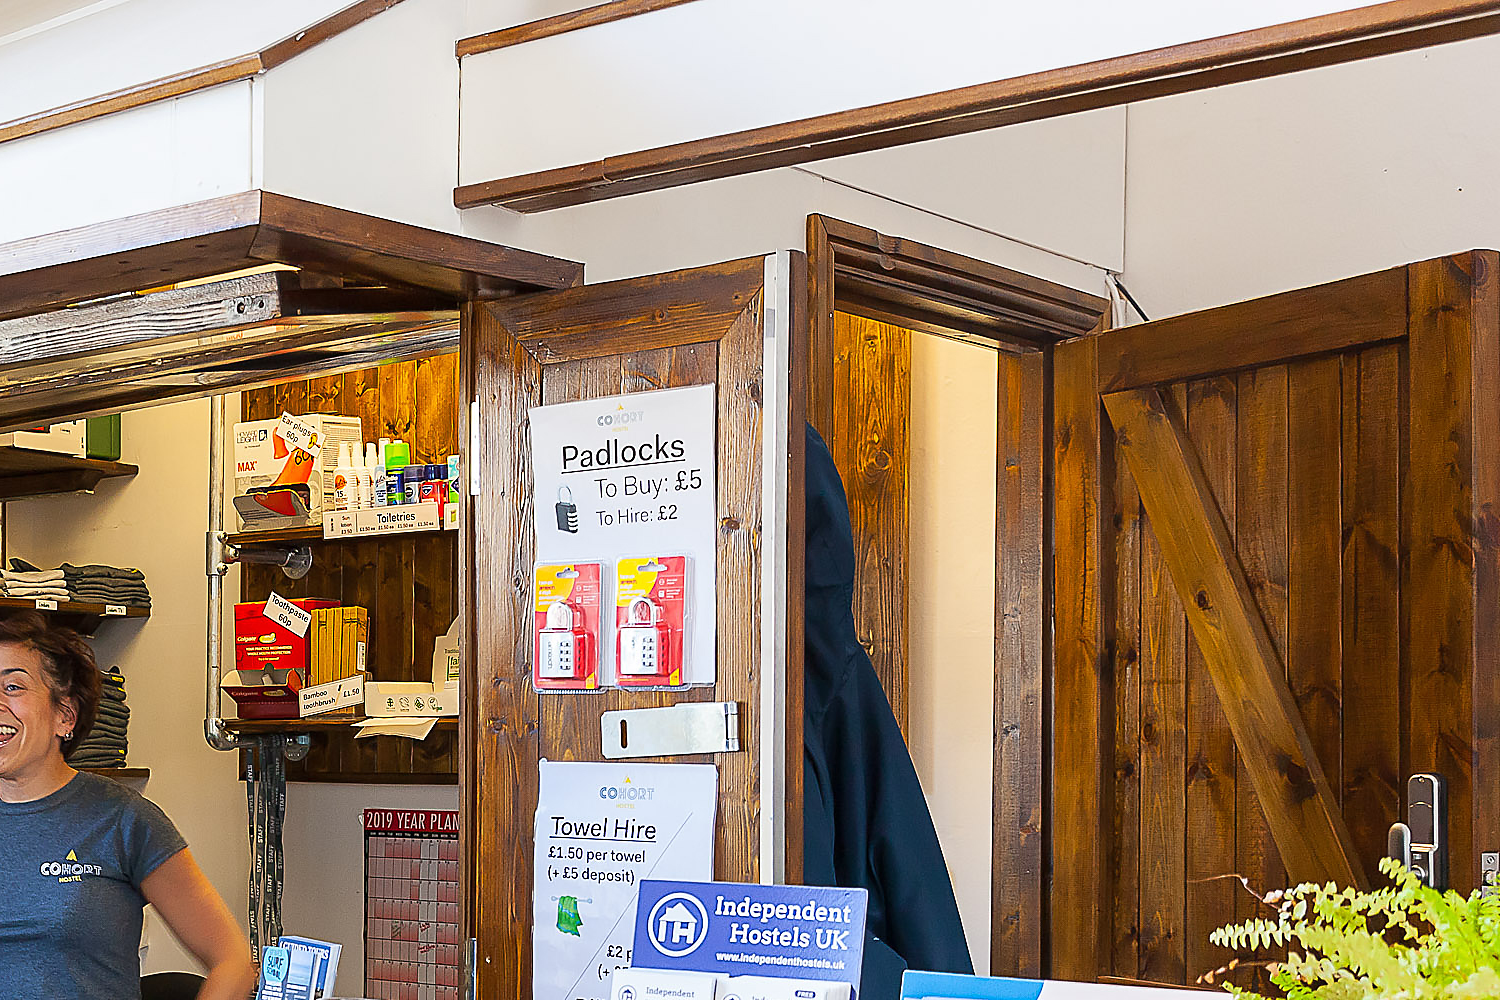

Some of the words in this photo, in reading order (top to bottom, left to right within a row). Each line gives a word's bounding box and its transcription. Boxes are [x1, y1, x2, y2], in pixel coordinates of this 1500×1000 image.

[281, 415, 294, 426] Ear
[293, 423, 312, 437] plugs
[597, 410, 644, 427] COHORT
[286, 430, 299, 443] 60p
[561, 433, 685, 471] Padlocks
[594, 478, 618, 499] To
[624, 476, 669, 500] Buy:
[674, 469, 702, 492] £5
[377, 512, 416, 524] Toiletries
[596, 510, 614, 526] To
[618, 507, 653, 525] Hire:
[657, 504, 678, 521] £2
[271, 595, 310, 623] Toothpaste
[278, 613, 293, 628] 60p
[303, 689, 328, 701] Bamboo
[303, 697, 336, 710] toothbrush
[343, 687, 360, 698] £1.50
[600, 786, 654, 801] COHORT
[366, 812, 393, 829] 2019
[397, 812, 426, 830] YEAR
[551, 817, 607, 837] Towel
[614, 819, 657, 840] Hire
[548, 846, 583, 860] £1.50
[586, 850, 607, 863] per
[610, 849, 645, 863] towel
[40, 861, 102, 876] COHORT
[547, 865, 560, 882] (+
[562, 866, 579, 880] £5
[581, 868, 635, 886] deposit)
[58, 875, 83, 884] HOSTEL
[714, 895, 852, 924] Independent
[729, 923, 810, 949] Hostels
[815, 927, 851, 951] UK
[606, 945, 623, 959] £2
[715, 951, 845, 971] www.independenthostels.uk
[645, 986, 695, 999] Independent
